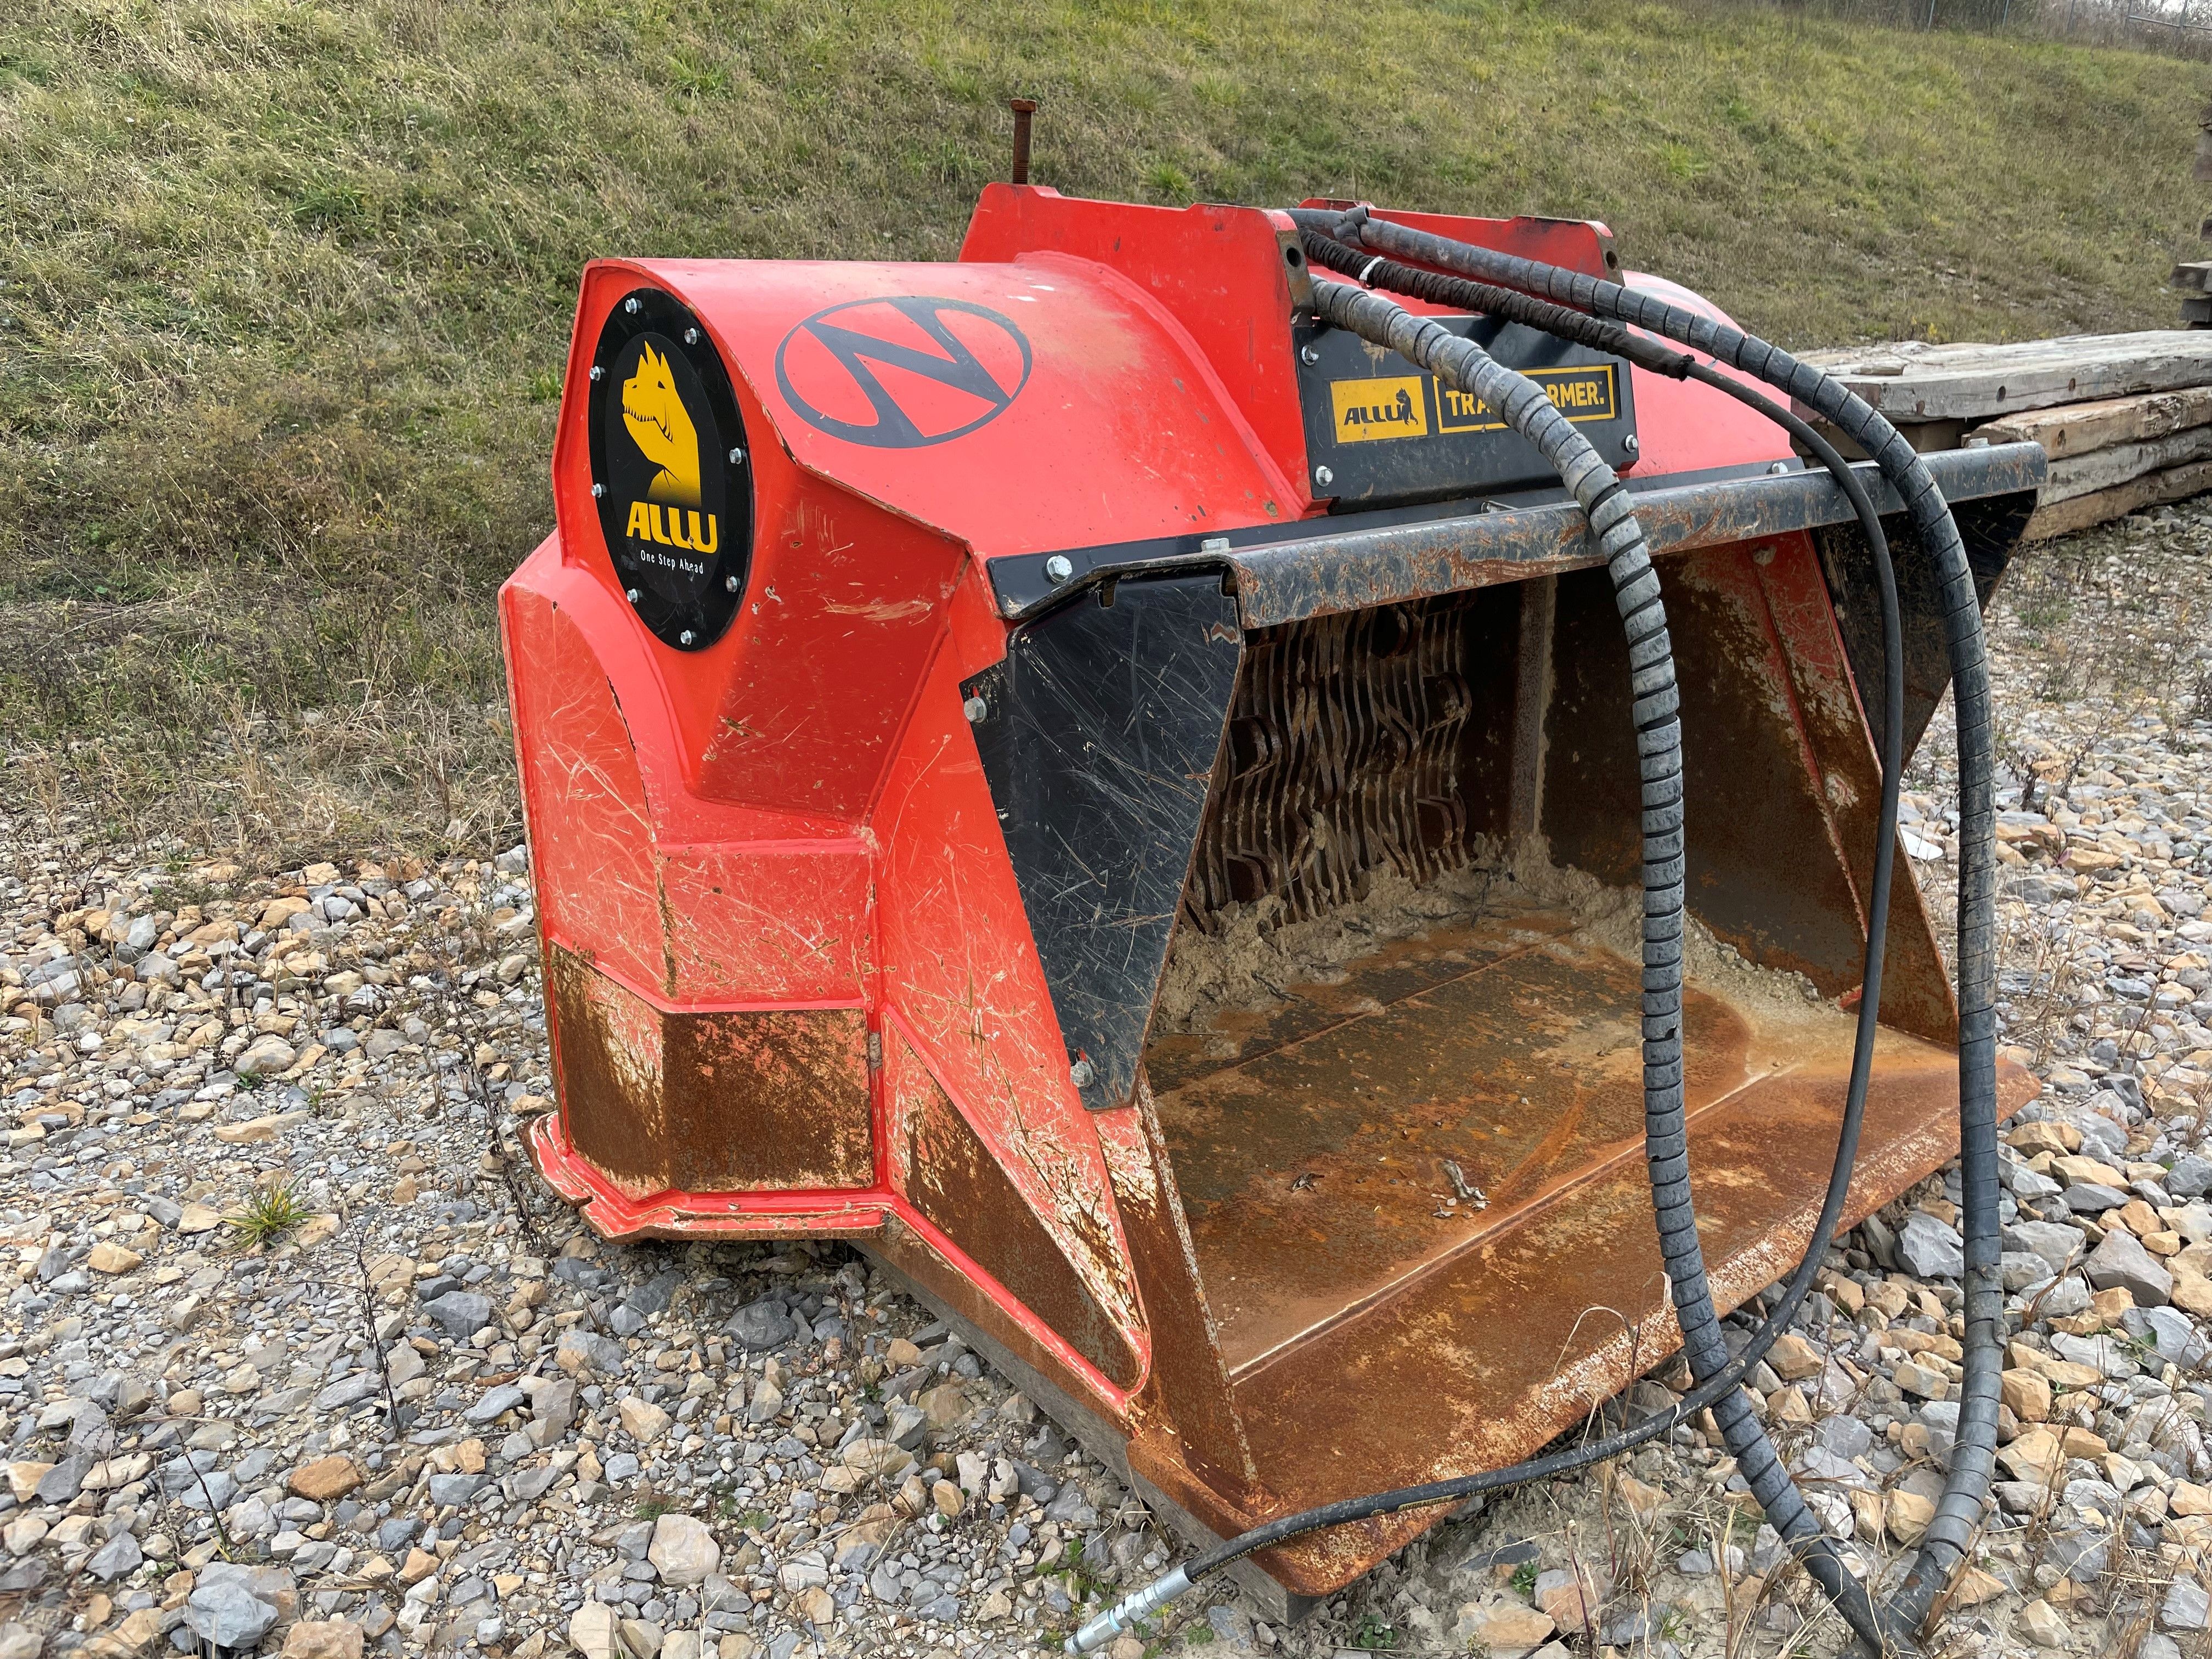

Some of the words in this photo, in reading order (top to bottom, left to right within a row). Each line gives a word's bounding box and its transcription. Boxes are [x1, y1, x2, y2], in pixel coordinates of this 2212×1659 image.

[1344, 404, 1404, 426] ALLU
[1446, 381, 1604, 416] TRARMER.
[626, 501, 718, 554] ALLU
[640, 549, 655, 563] One
[658, 553, 675, 571] Step
[679, 558, 703, 574] Ahead
[1192, 1571, 1209, 1584] AME
[1210, 1548, 1252, 1575] RESISTANT
[1254, 1539, 1278, 1553] MSHA
